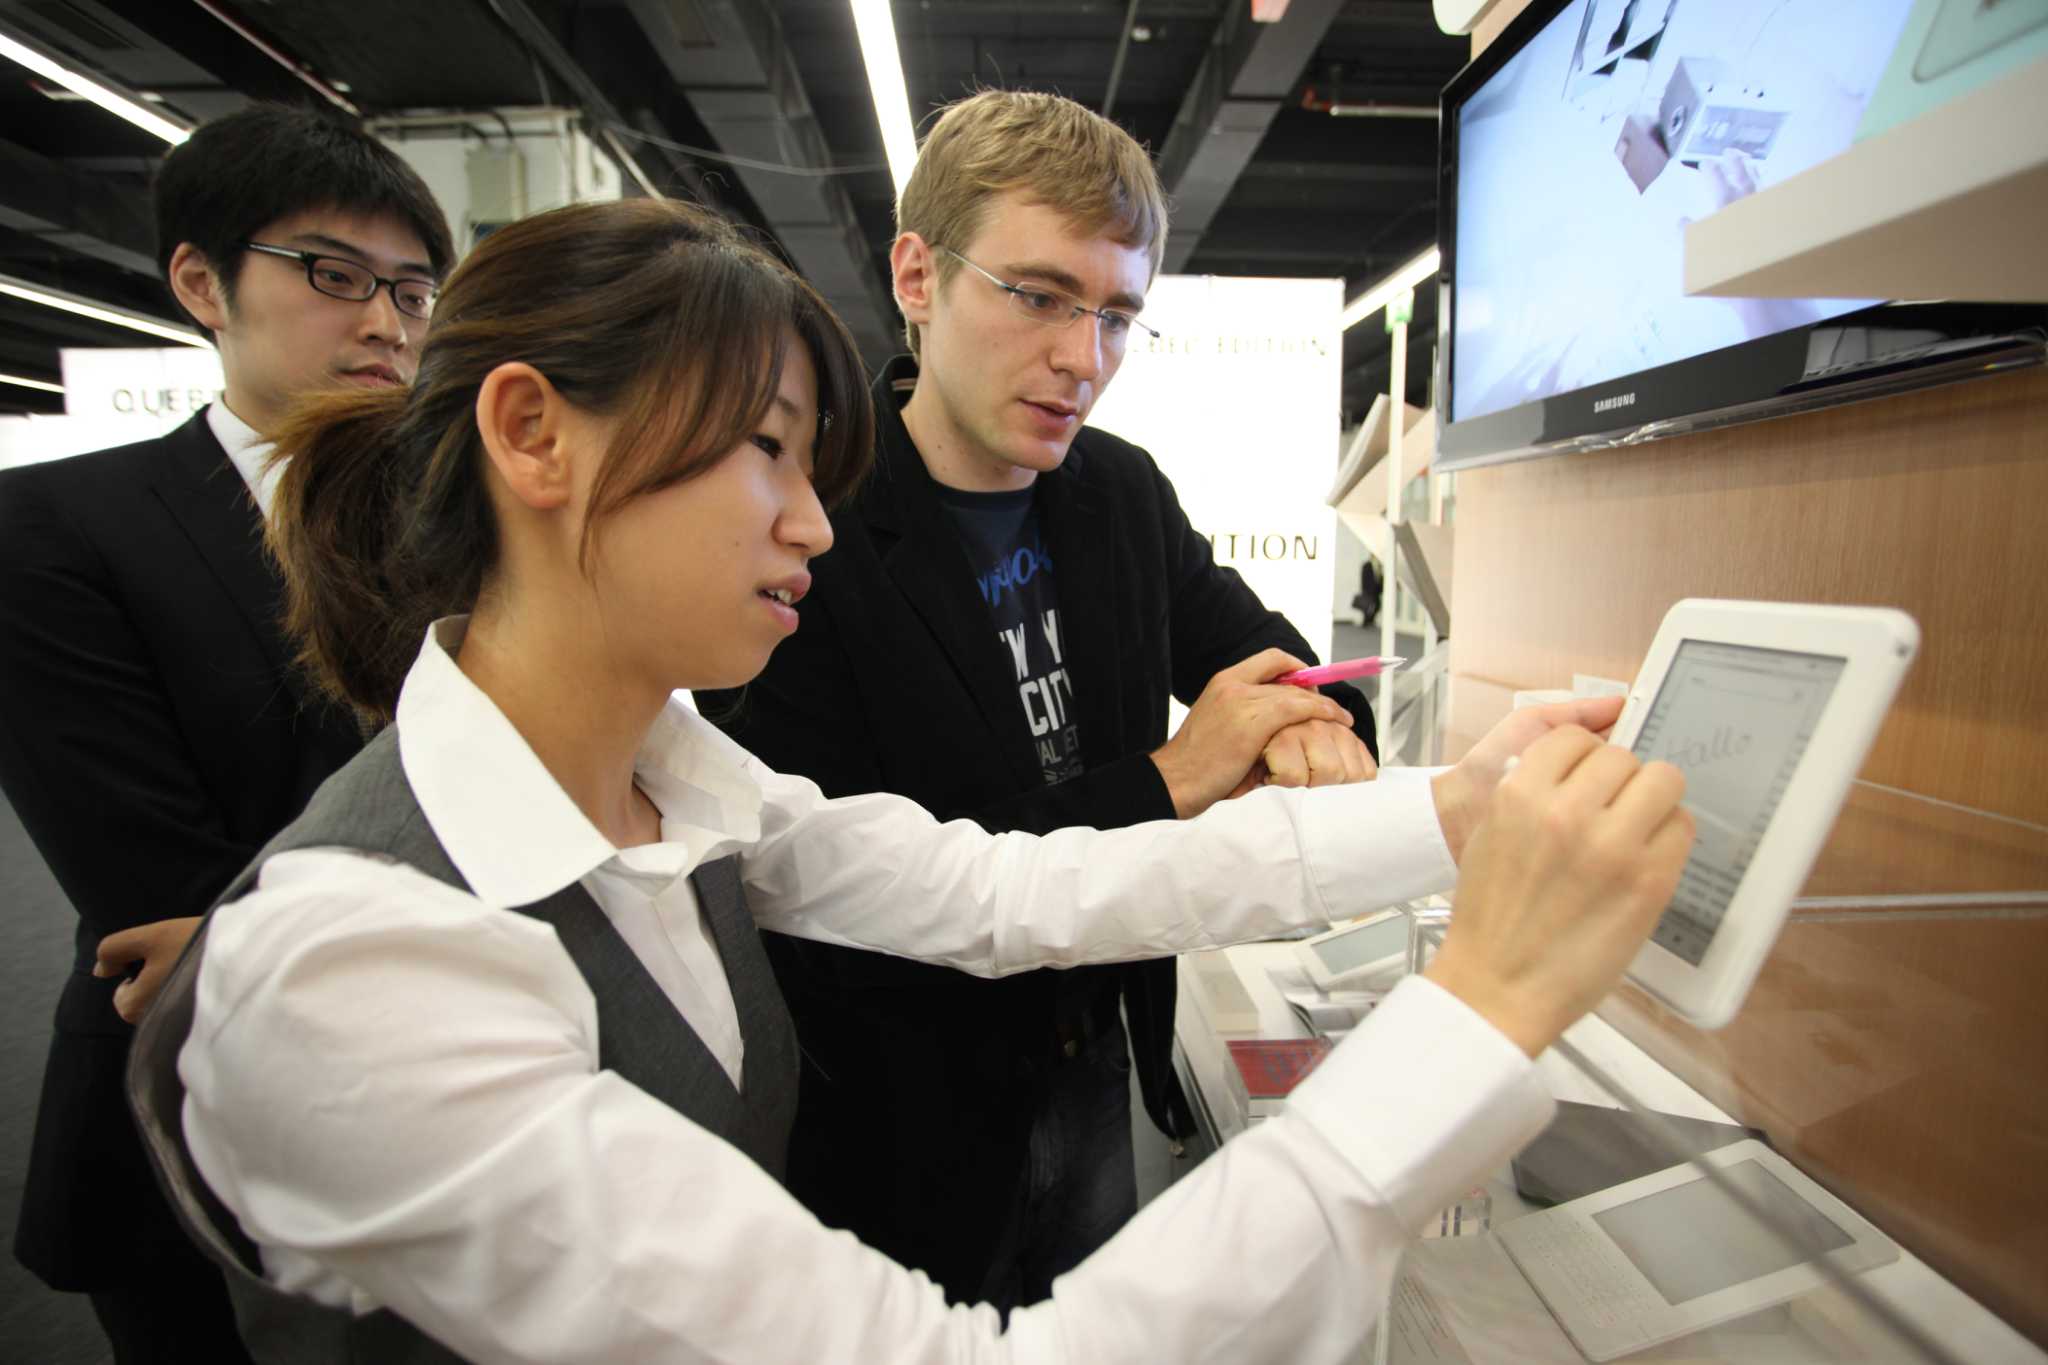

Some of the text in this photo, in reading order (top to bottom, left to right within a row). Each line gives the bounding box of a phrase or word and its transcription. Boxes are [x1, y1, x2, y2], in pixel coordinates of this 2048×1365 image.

[111, 387, 222, 413] QUEB
[1593, 392, 1636, 414] SAMSUNG
[999, 622, 1030, 682] W
